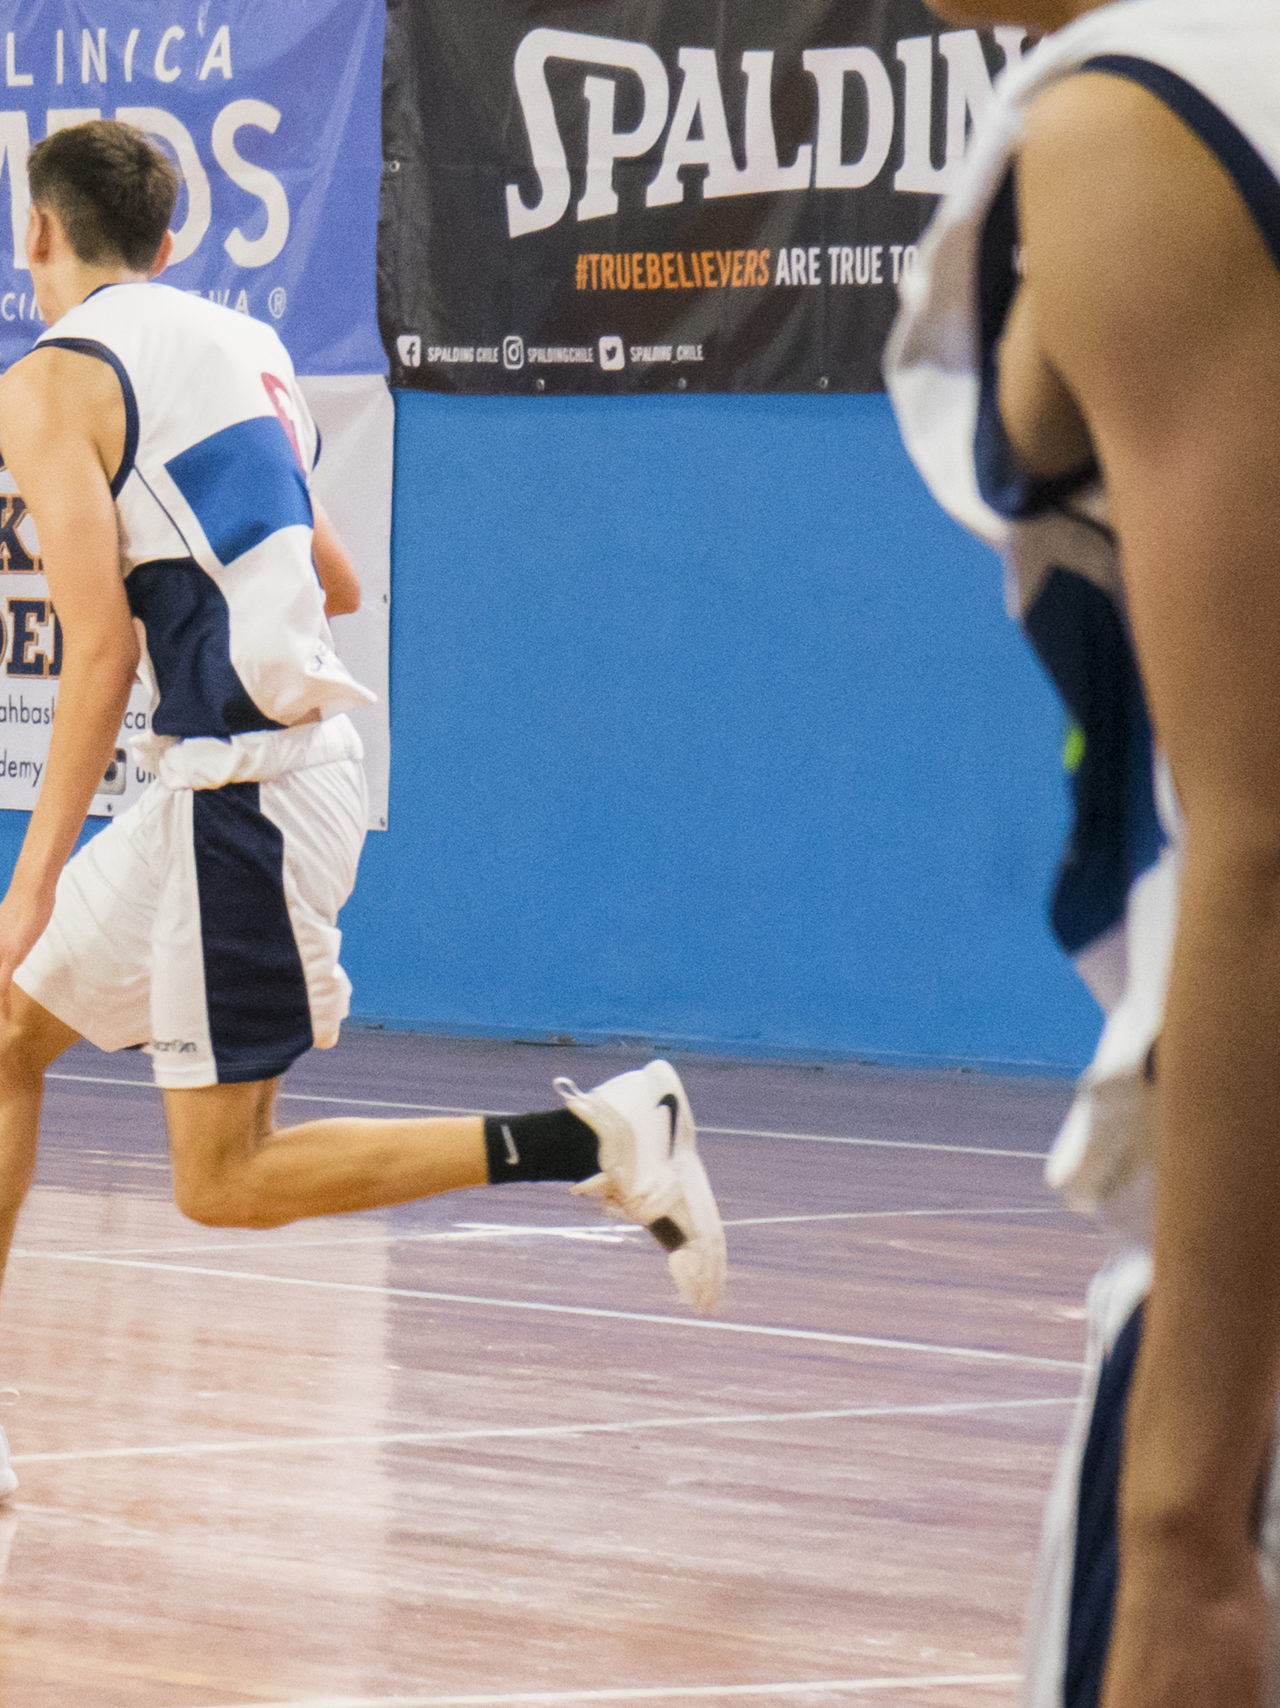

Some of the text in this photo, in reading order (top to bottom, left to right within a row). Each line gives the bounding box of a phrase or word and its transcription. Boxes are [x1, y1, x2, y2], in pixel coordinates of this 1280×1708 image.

[505, 25, 1030, 238] SPALDIN
[575, 249, 770, 290] #TRUEBELIEVERS
[775, 247, 820, 286] ARE
[828, 245, 883, 285] TRUE
